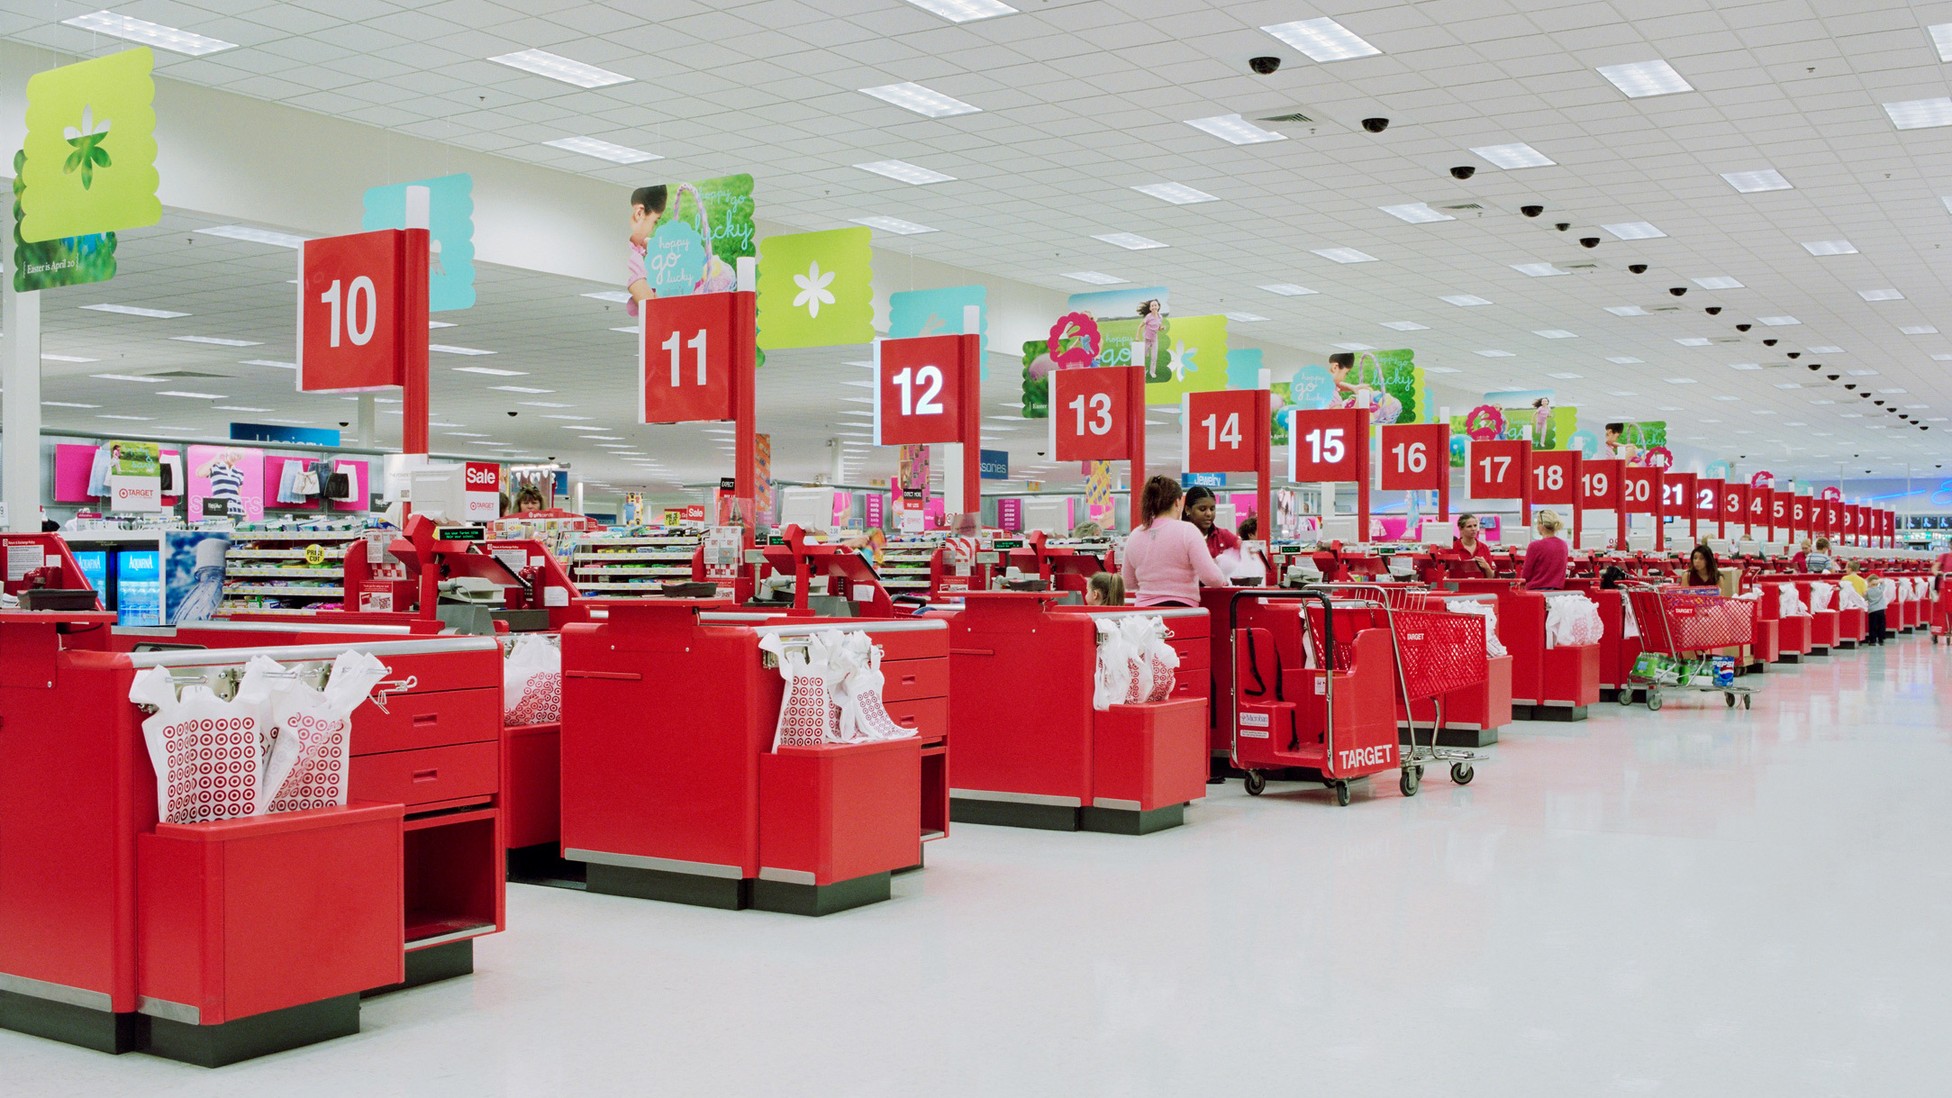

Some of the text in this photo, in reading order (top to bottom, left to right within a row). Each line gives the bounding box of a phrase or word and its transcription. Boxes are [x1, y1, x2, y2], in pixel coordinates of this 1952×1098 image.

[731, 195, 746, 213] go
[27, 259, 75, 274] Easter is April 20
[651, 252, 681, 285] go
[666, 268, 693, 285] lucky
[321, 275, 377, 348] 10
[661, 329, 708, 387] 11
[1101, 347, 1132, 366] go
[893, 366, 943, 416] 12
[1295, 384, 1318, 401] go
[1069, 393, 1112, 436] 13
[1201, 412, 1242, 450] 14
[1305, 428, 1345, 464] 15
[1392, 443, 1427, 473] 16
[1479, 456, 1512, 483] 17
[466, 467, 496, 484] Sale
[1194, 473, 1222, 486] Jewelry
[1533, 465, 1563, 491] 18
[1582, 473, 1608, 497] 19
[128, 489, 153, 497] TARGET
[1625, 479, 1650, 501] 20
[1663, 484, 1683, 505] 21
[689, 508, 703, 518] Sale
[1712, 660, 1734, 668] PEPSI
[1339, 744, 1393, 770] TARGET
